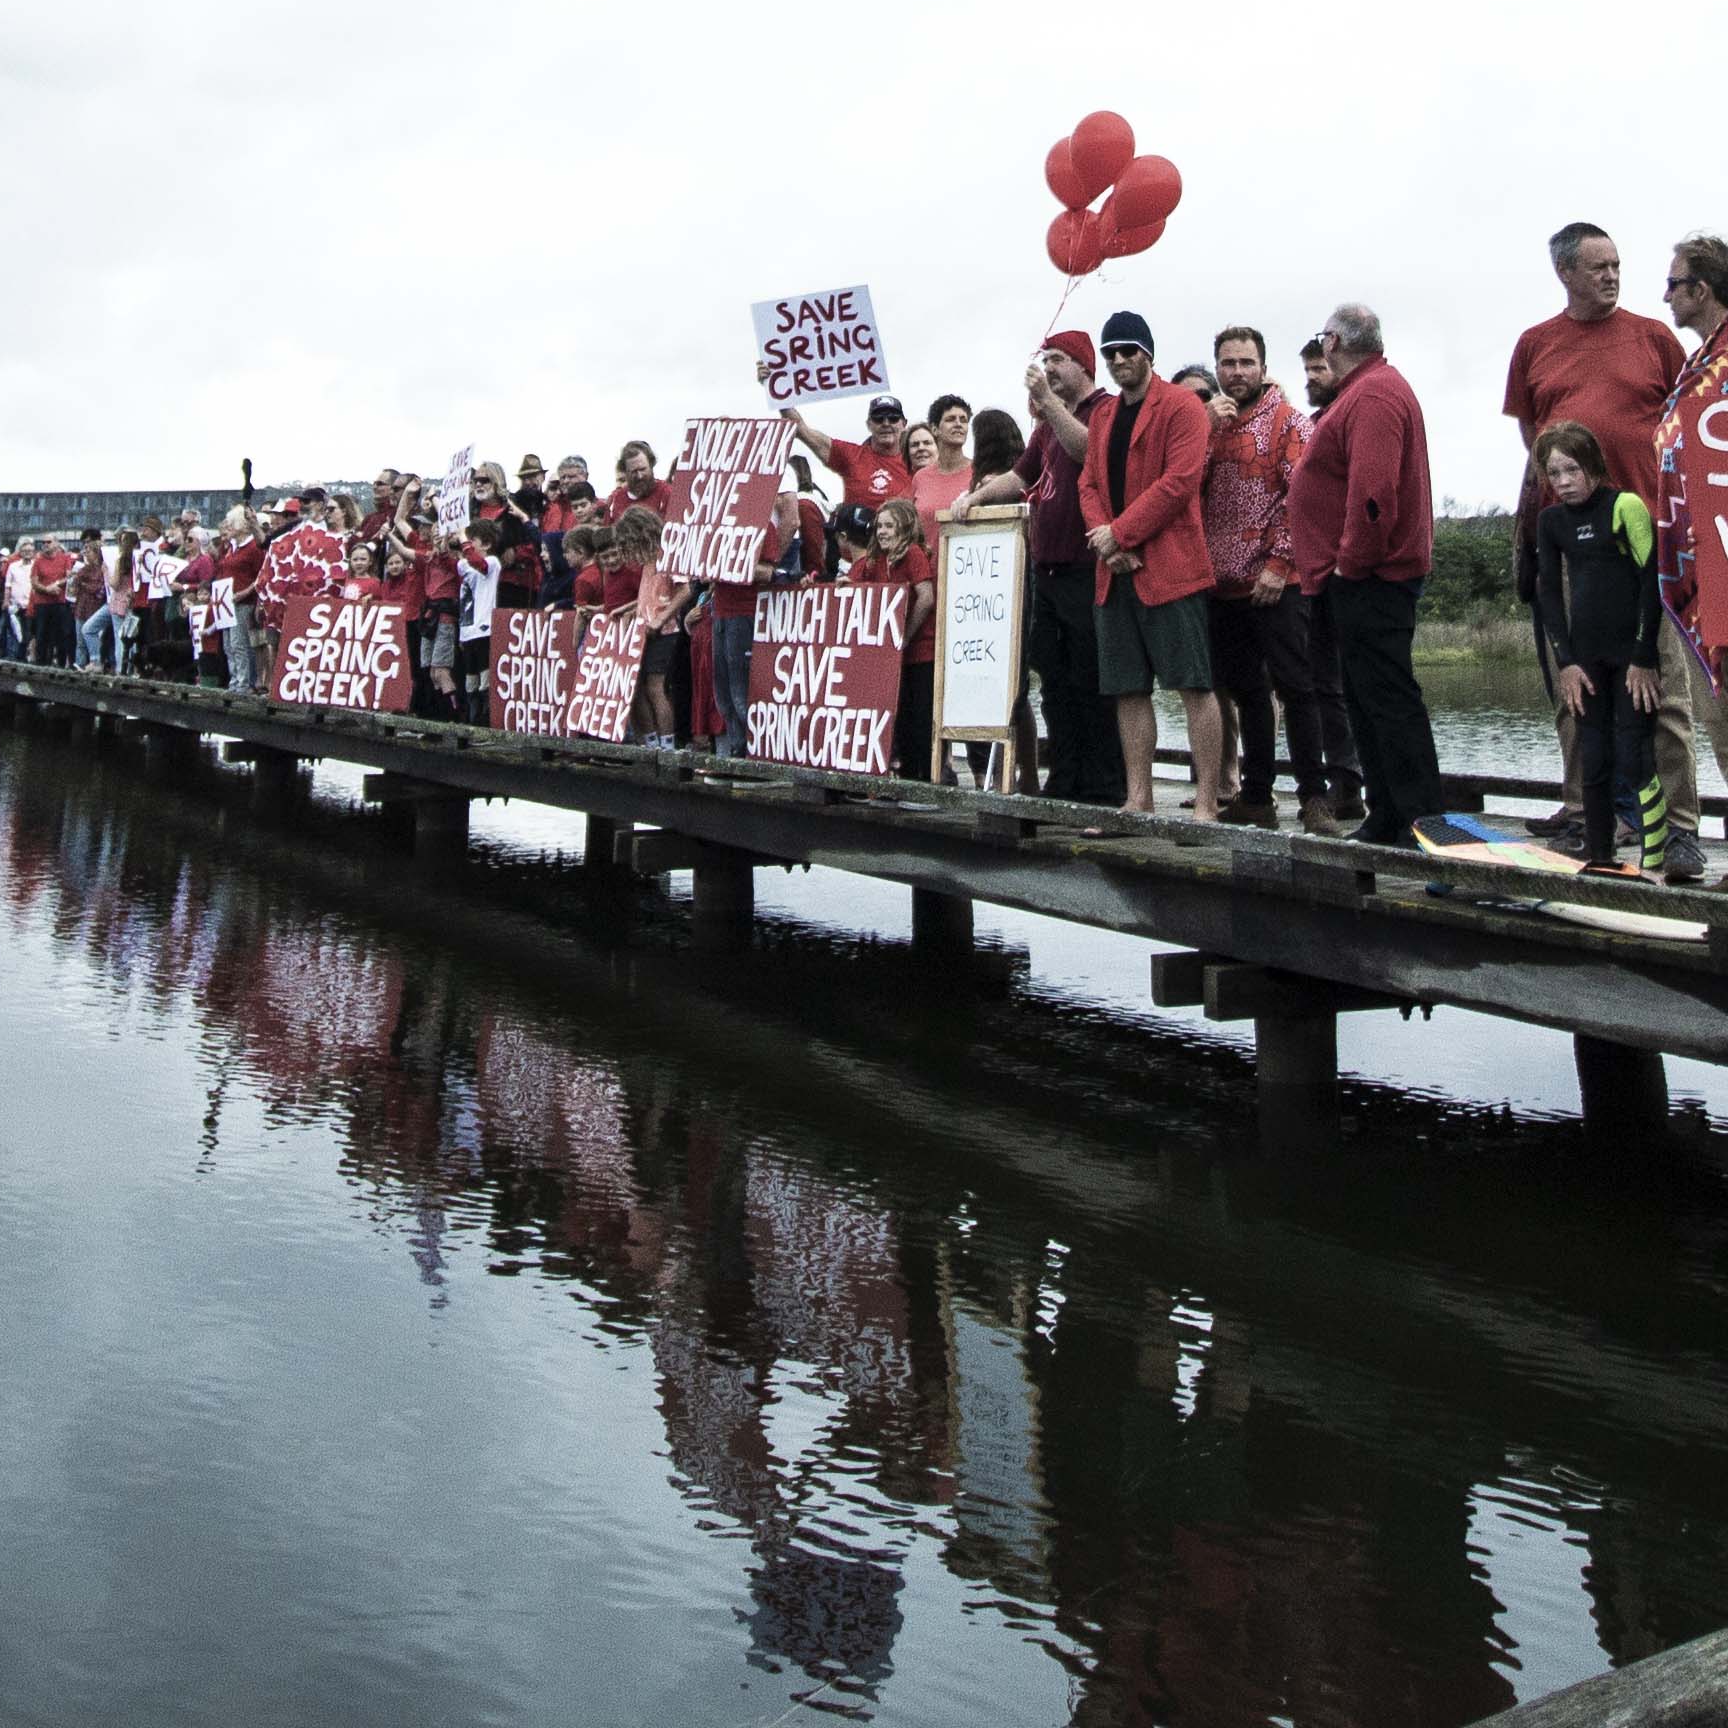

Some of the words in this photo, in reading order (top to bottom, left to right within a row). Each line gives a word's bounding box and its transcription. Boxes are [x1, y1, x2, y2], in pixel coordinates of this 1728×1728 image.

[776, 291, 859, 333] SAVE
[769, 357, 882, 400] CREEK
[676, 420, 753, 472] ENOUGH
[744, 421, 797, 475] TALK
[683, 471, 751, 526] SAVE
[656, 521, 712, 577] SPRING
[706, 526, 768, 584] CREEK
[954, 546, 1000, 578] SAVE
[306, 604, 402, 643] SAVE
[753, 587, 828, 644] ENOUGH
[954, 593, 1004, 624] SPRING
[285, 637, 401, 679] SPRING
[508, 612, 563, 658] SAVE
[586, 613, 645, 658] SAVE
[952, 639, 996, 665] CREEK
[497, 654, 567, 706] SPRING
[575, 655, 640, 704] SPRING
[772, 645, 851, 707] SAVE
[567, 694, 631, 742] CREEK
[746, 701, 809, 764] SPRING
[808, 706, 890, 774] CREEK
